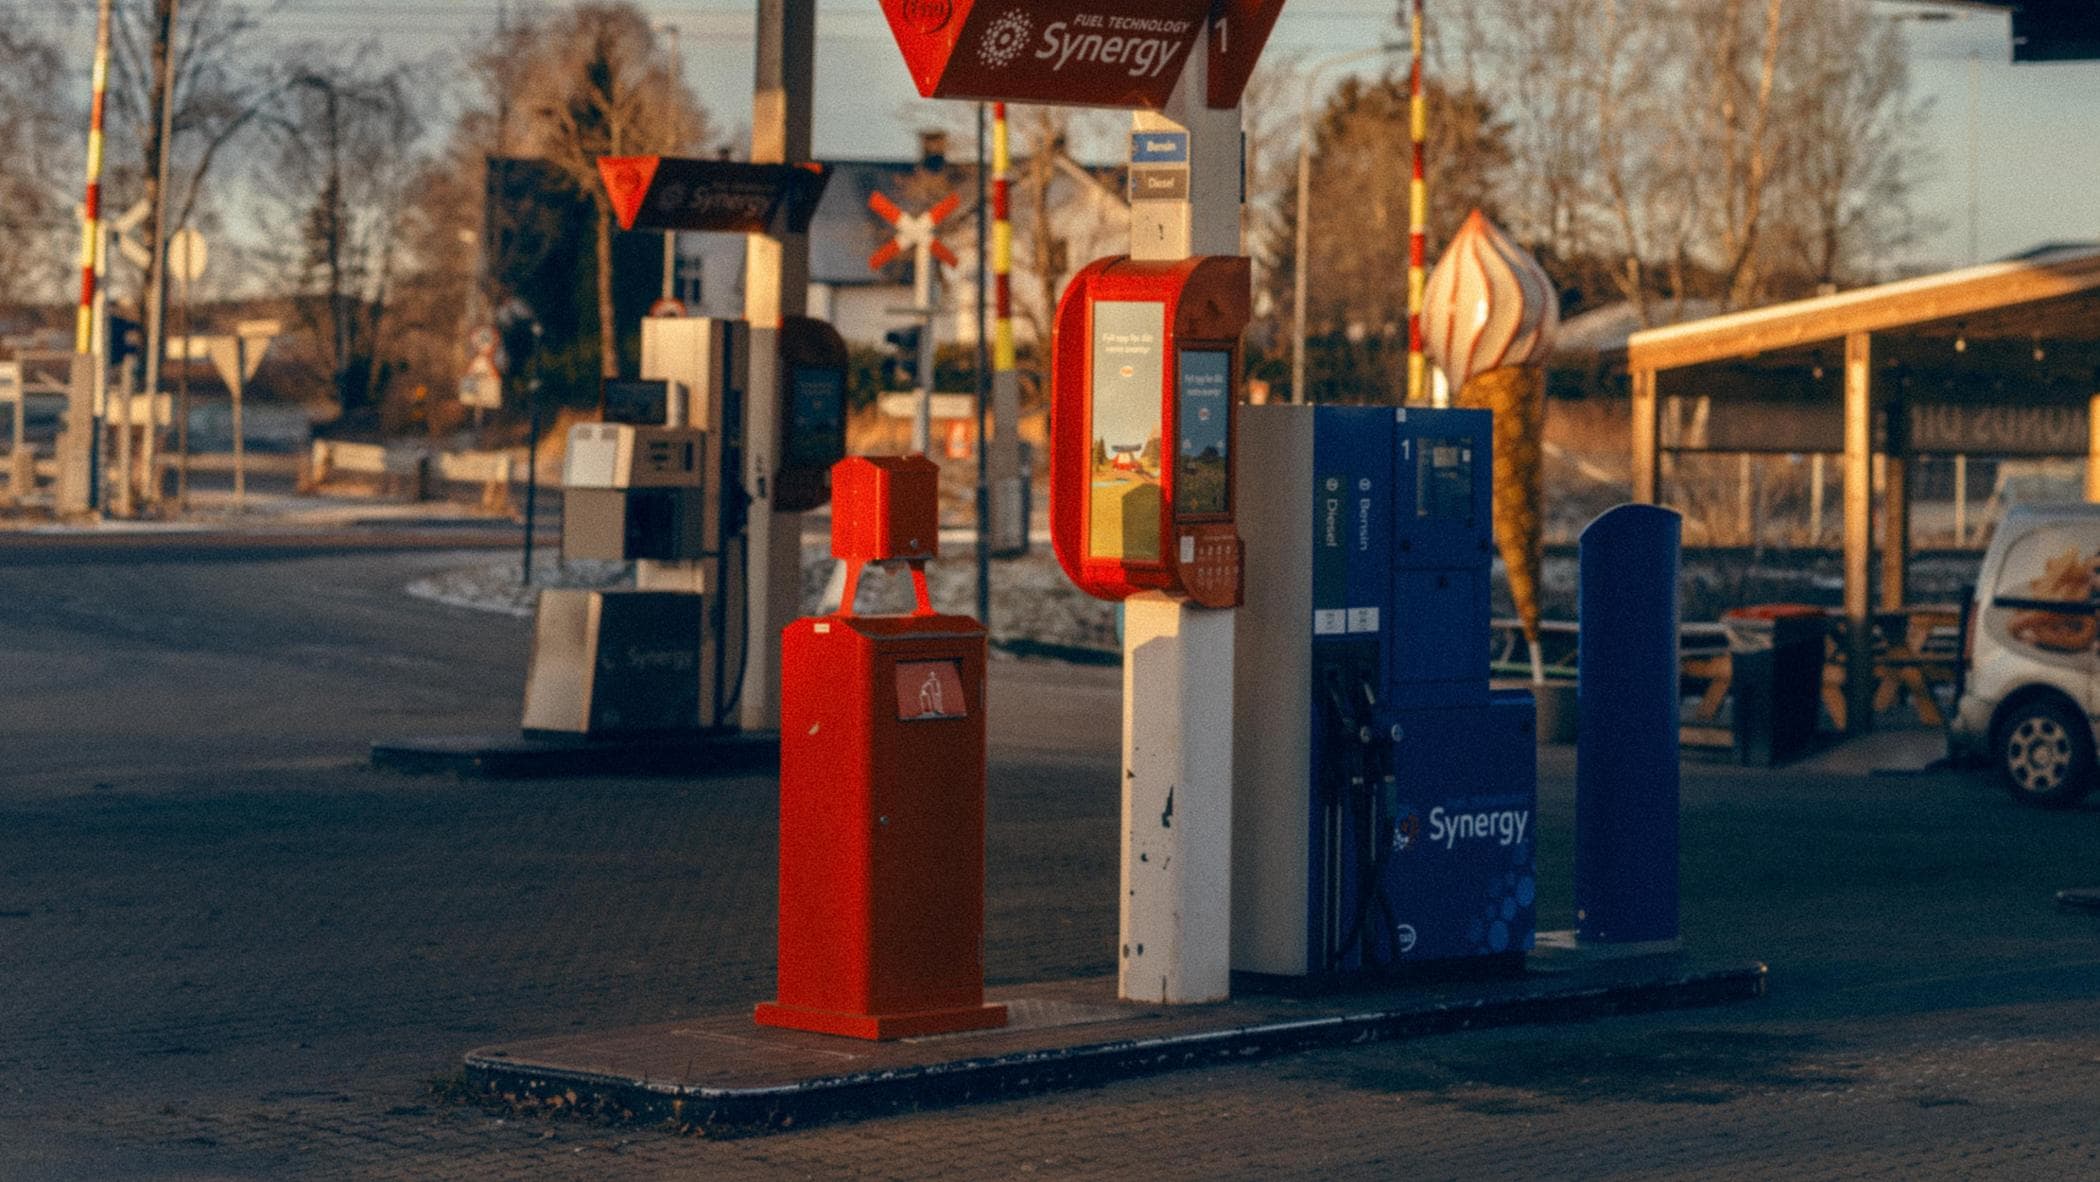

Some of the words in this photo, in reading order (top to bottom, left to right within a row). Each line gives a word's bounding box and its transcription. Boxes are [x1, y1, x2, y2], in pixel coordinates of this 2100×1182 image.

[1074, 14, 1104, 28] FUEL
[1109, 16, 1191, 33] TECHNOLOGY
[1214, 17, 1228, 53] 1
[1035, 21, 1181, 77] Synergy
[1401, 439, 1410, 461] 1
[1326, 498, 1338, 547] Diesel
[1359, 498, 1371, 551] Bensin
[1429, 806, 1528, 849] Synergy
